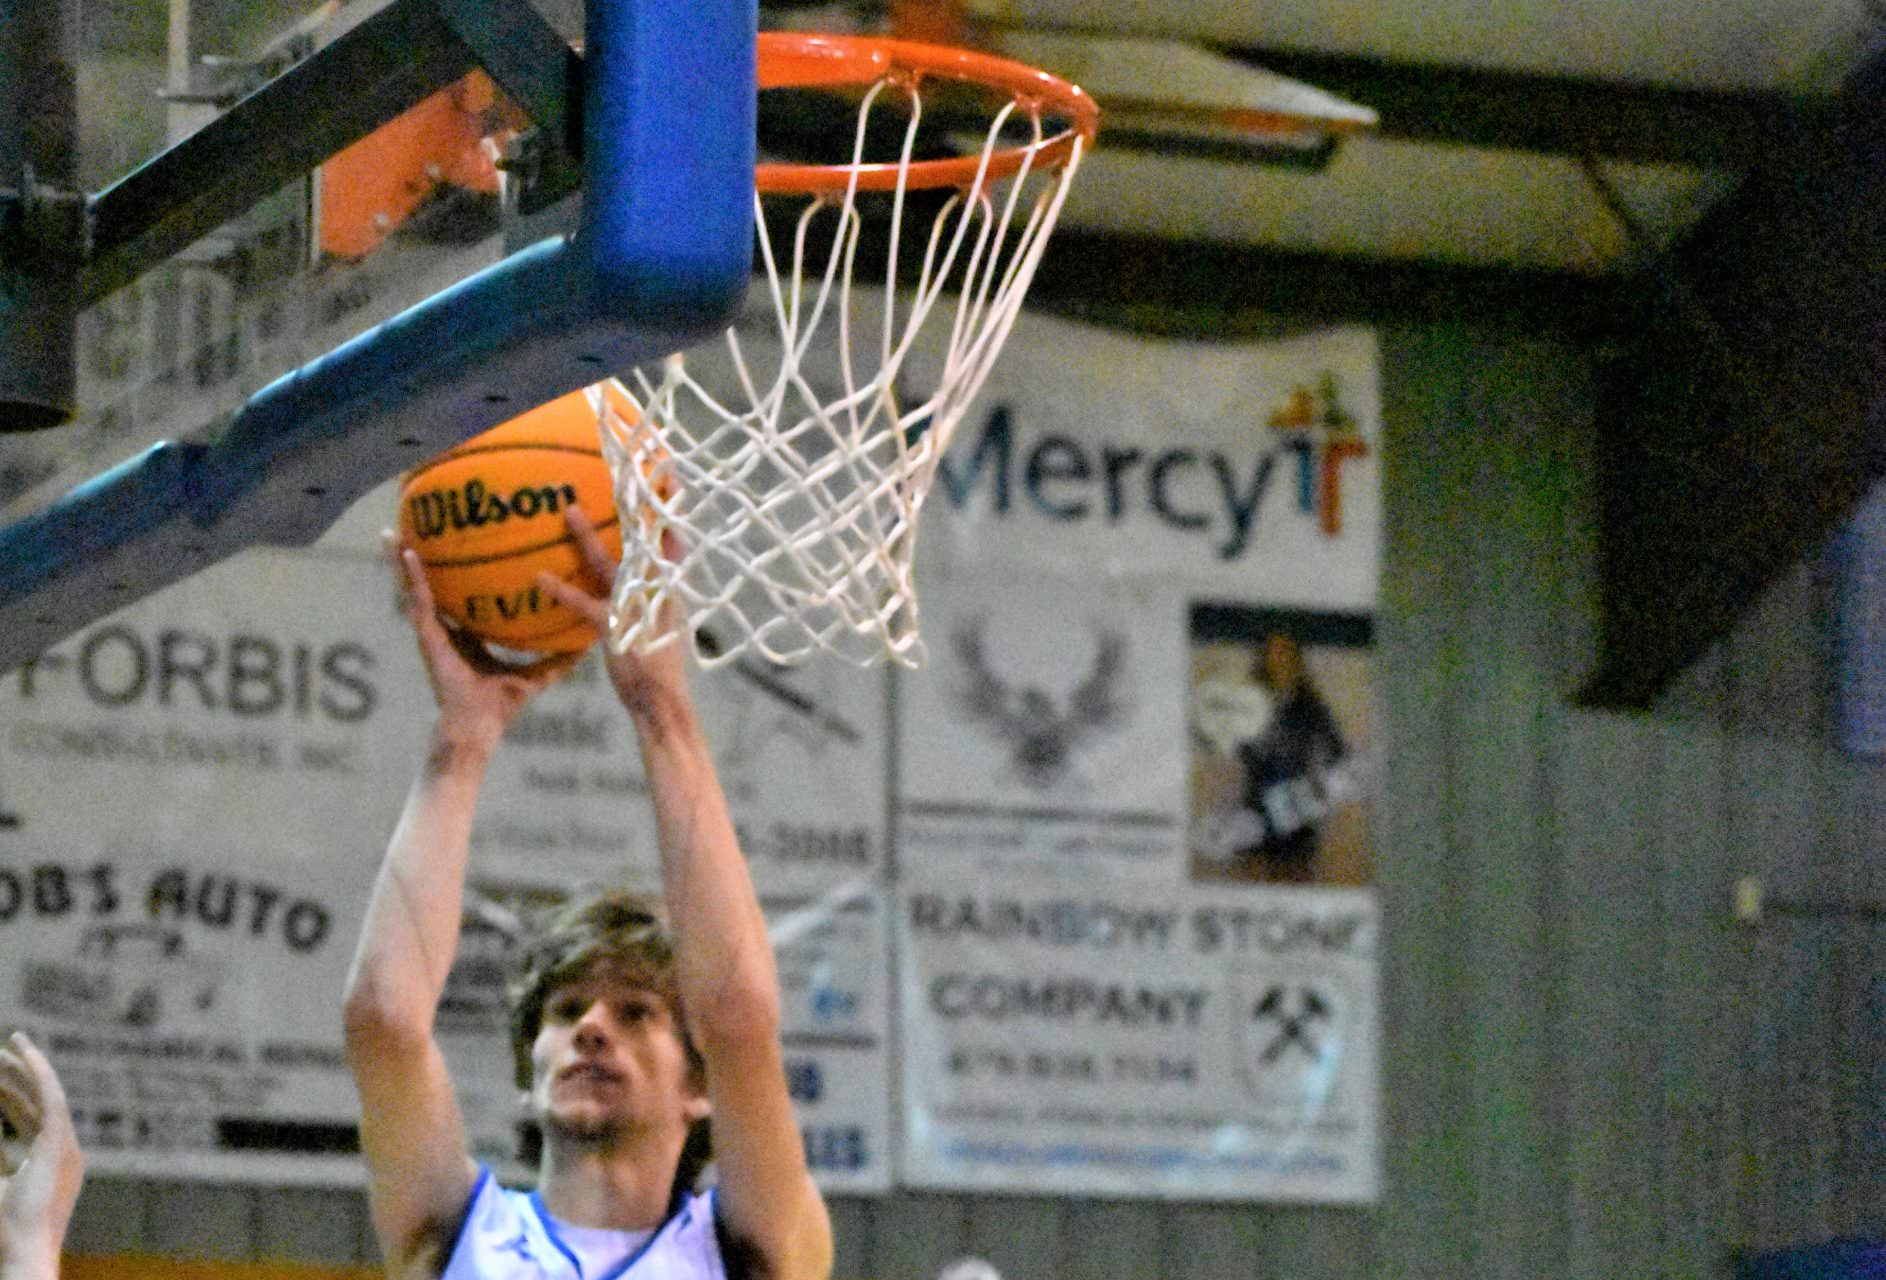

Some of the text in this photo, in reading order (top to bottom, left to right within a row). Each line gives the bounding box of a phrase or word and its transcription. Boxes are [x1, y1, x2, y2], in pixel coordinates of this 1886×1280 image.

[410, 479, 575, 540] Wilson
[905, 405, 1276, 561] Mercy
[146, 867, 331, 953] AUTO
[930, 973, 1210, 1026] COMPANY
